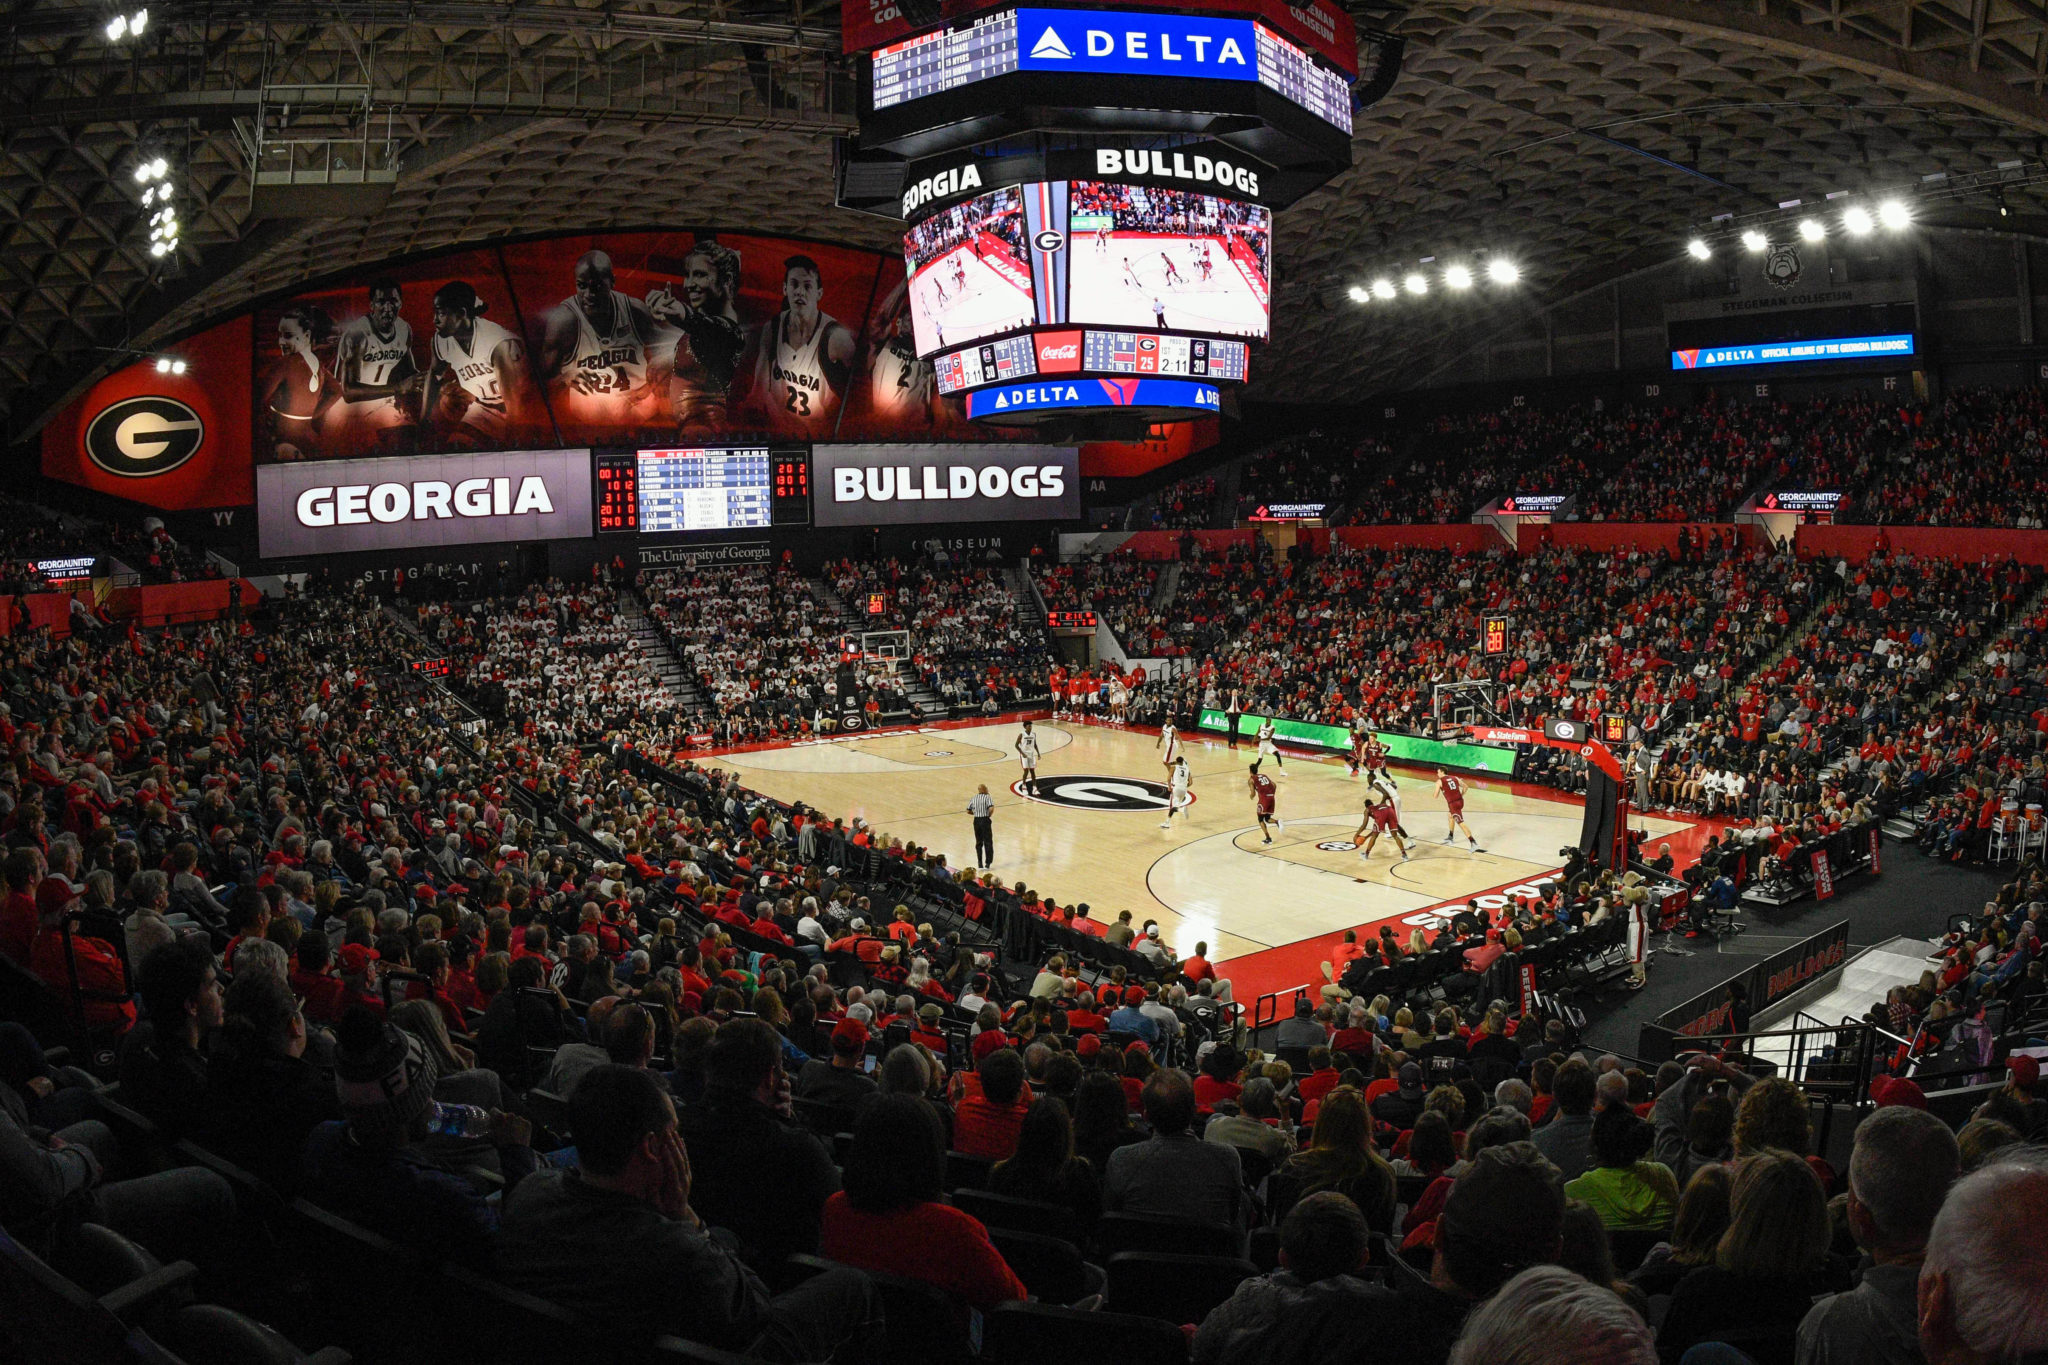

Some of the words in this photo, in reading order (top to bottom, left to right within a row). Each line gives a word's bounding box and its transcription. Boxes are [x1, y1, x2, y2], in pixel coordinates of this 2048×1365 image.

[985, 16, 993, 24] AST
[1290, 6, 1335, 44] COLISEUM
[1086, 30, 1247, 65] DELTA
[952, 53, 969, 66] MYERS
[1096, 149, 1260, 196] BULLDOGS
[1722, 296, 1786, 312] STEGEMAN
[1792, 291, 1852, 304] COLISEUM
[363, 350, 404, 362] GEORGIA
[577, 348, 639, 370] GEORGIA
[1718, 350, 1754, 362] DELTA
[1816, 346, 1826, 354] OF
[1826, 344, 1839, 353] THE
[1141, 357, 1153, 369] 25
[1162, 359, 1187, 372] 2:11
[1194, 361, 1205, 373] 30
[374, 364, 384, 383] 1
[773, 364, 820, 392] GEORGIA
[896, 364, 911, 388] 2
[986, 366, 995, 379] 30
[1884, 377, 1896, 390] FF
[1012, 386, 1079, 405] DELTA
[1646, 384, 1660, 397] DD
[1756, 384, 1768, 397] EE
[786, 387, 812, 417] 23
[1513, 396, 1525, 406] CC
[1384, 408, 1396, 418] BB
[600, 469, 611, 478] 00
[626, 469, 633, 477] 4
[779, 464, 784, 473] 2
[787, 465, 793, 473] 0
[800, 464, 805, 473] 2
[614, 482, 619, 490] 0
[625, 481, 633, 490] 12
[777, 476, 785, 484] 13
[787, 476, 793, 484] 0
[800, 476, 806, 484] 0
[834, 465, 1064, 501] BULLDOGS
[1090, 480, 1106, 492] AA
[606, 493, 612, 502] 3
[628, 493, 634, 502] 6
[777, 488, 786, 496] 15
[296, 476, 555, 527] GEORGIA
[600, 506, 612, 514] 20
[628, 505, 634, 514] 0
[214, 511, 234, 528] YY
[601, 518, 612, 526] 34
[615, 517, 621, 526] 0
[629, 517, 635, 526] 0
[638, 550, 661, 563] The
[662, 548, 715, 563] University
[716, 547, 728, 559] of
[729, 545, 770, 560] Georgia
[38, 558, 94, 570] GEORGIAUNITED
[1488, 621, 1504, 632] 2:11
[1487, 632, 1502, 651] 28
[1609, 718, 1624, 727] 2:11
[790, 728, 943, 746] GEORGIA
[1259, 776, 1270, 786] 30
[1768, 940, 1846, 998] BULLDOGS
